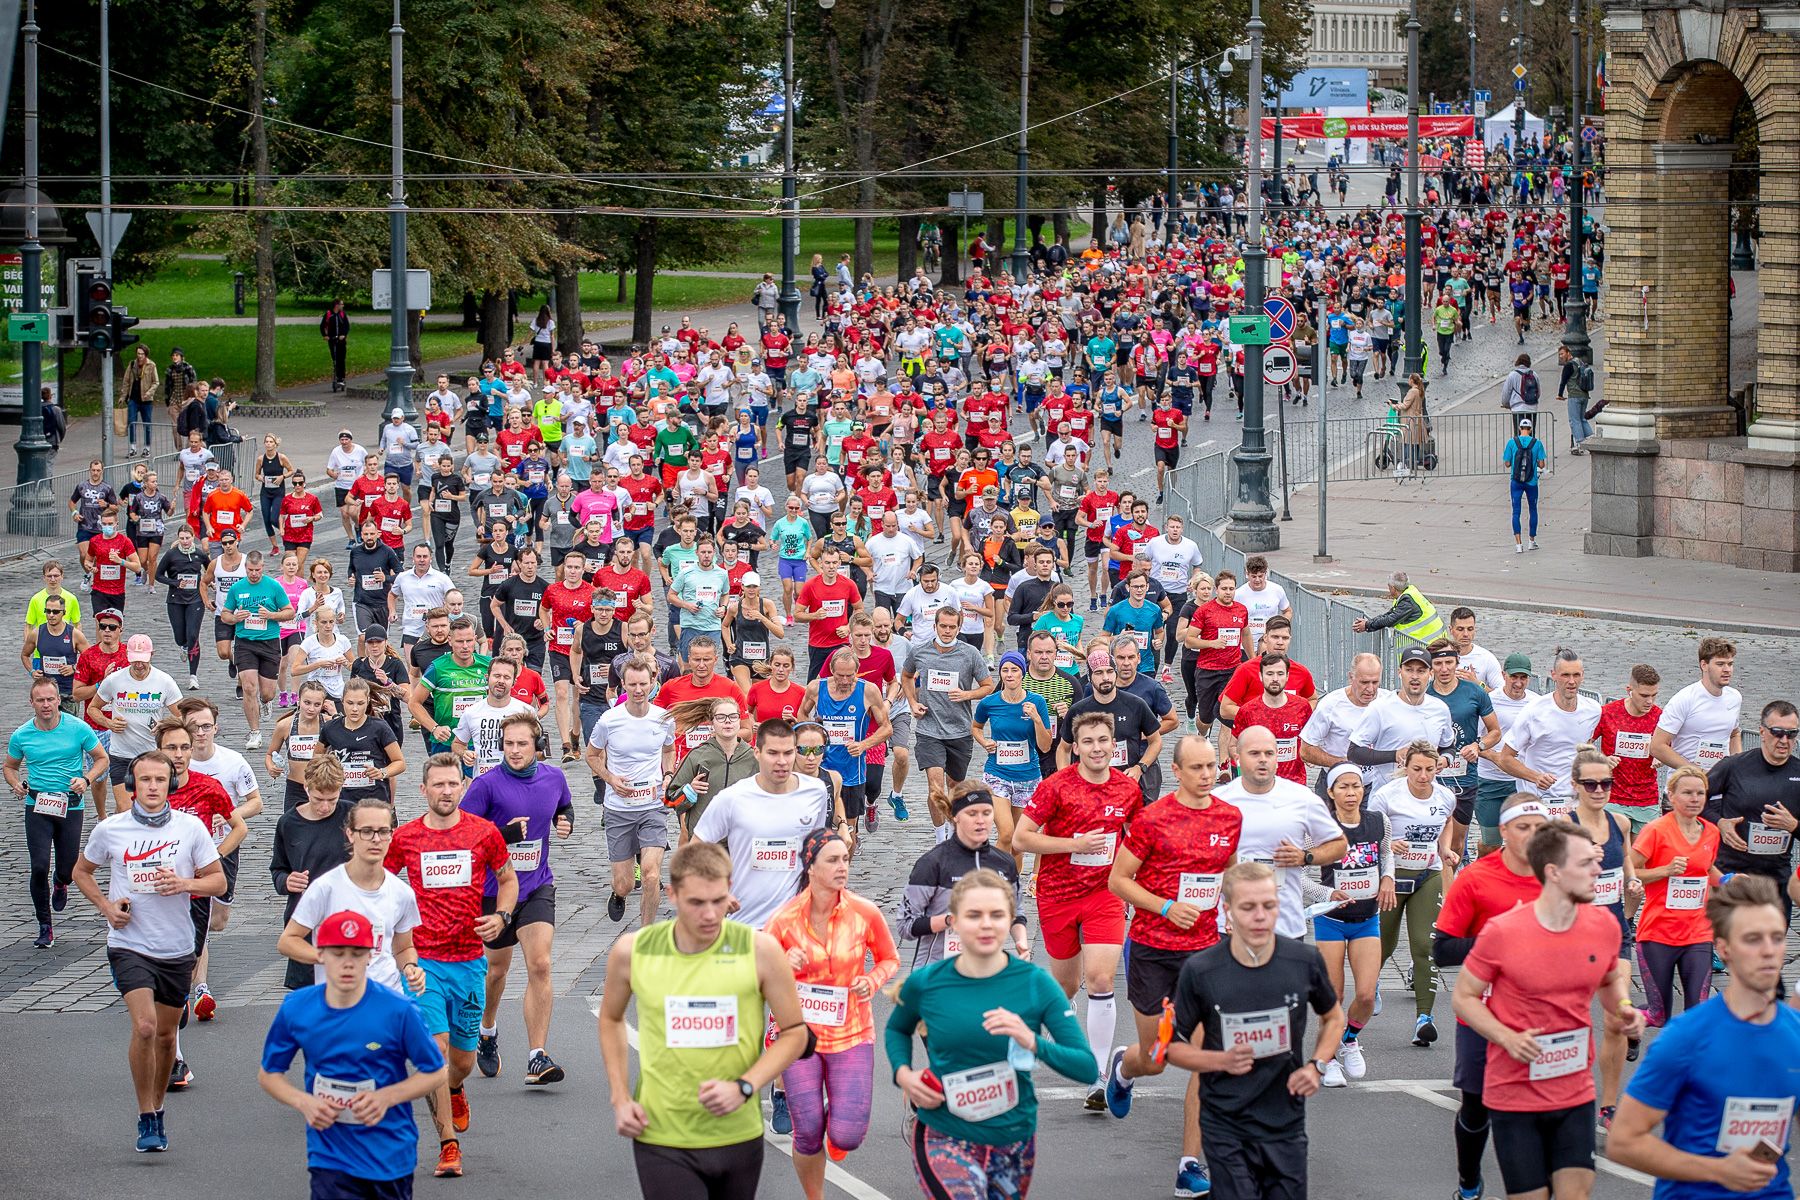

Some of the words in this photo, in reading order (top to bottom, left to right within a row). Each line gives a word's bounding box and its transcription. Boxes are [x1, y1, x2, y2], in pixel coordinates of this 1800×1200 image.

[532, 592, 542, 600] IBS
[604, 643, 618, 651] IBS
[451, 678, 485, 686] LIETUVA
[932, 677, 951, 685] 21412
[480, 740, 498, 749] WIT
[1620, 741, 1644, 750] 20373
[38, 796, 62, 808] 20775
[1754, 835, 1781, 845] 20521
[511, 853, 537, 862] 0566
[756, 850, 788, 861] 20518
[426, 865, 462, 876] 20627
[1341, 880, 1370, 891] 21308
[1595, 882, 1616, 894] 0184
[1185, 887, 1215, 898] 20613
[671, 1016, 725, 1030] 20509
[1232, 1028, 1273, 1045] 21414
[1535, 1046, 1579, 1065] 20203
[955, 1083, 1003, 1108] 20221
